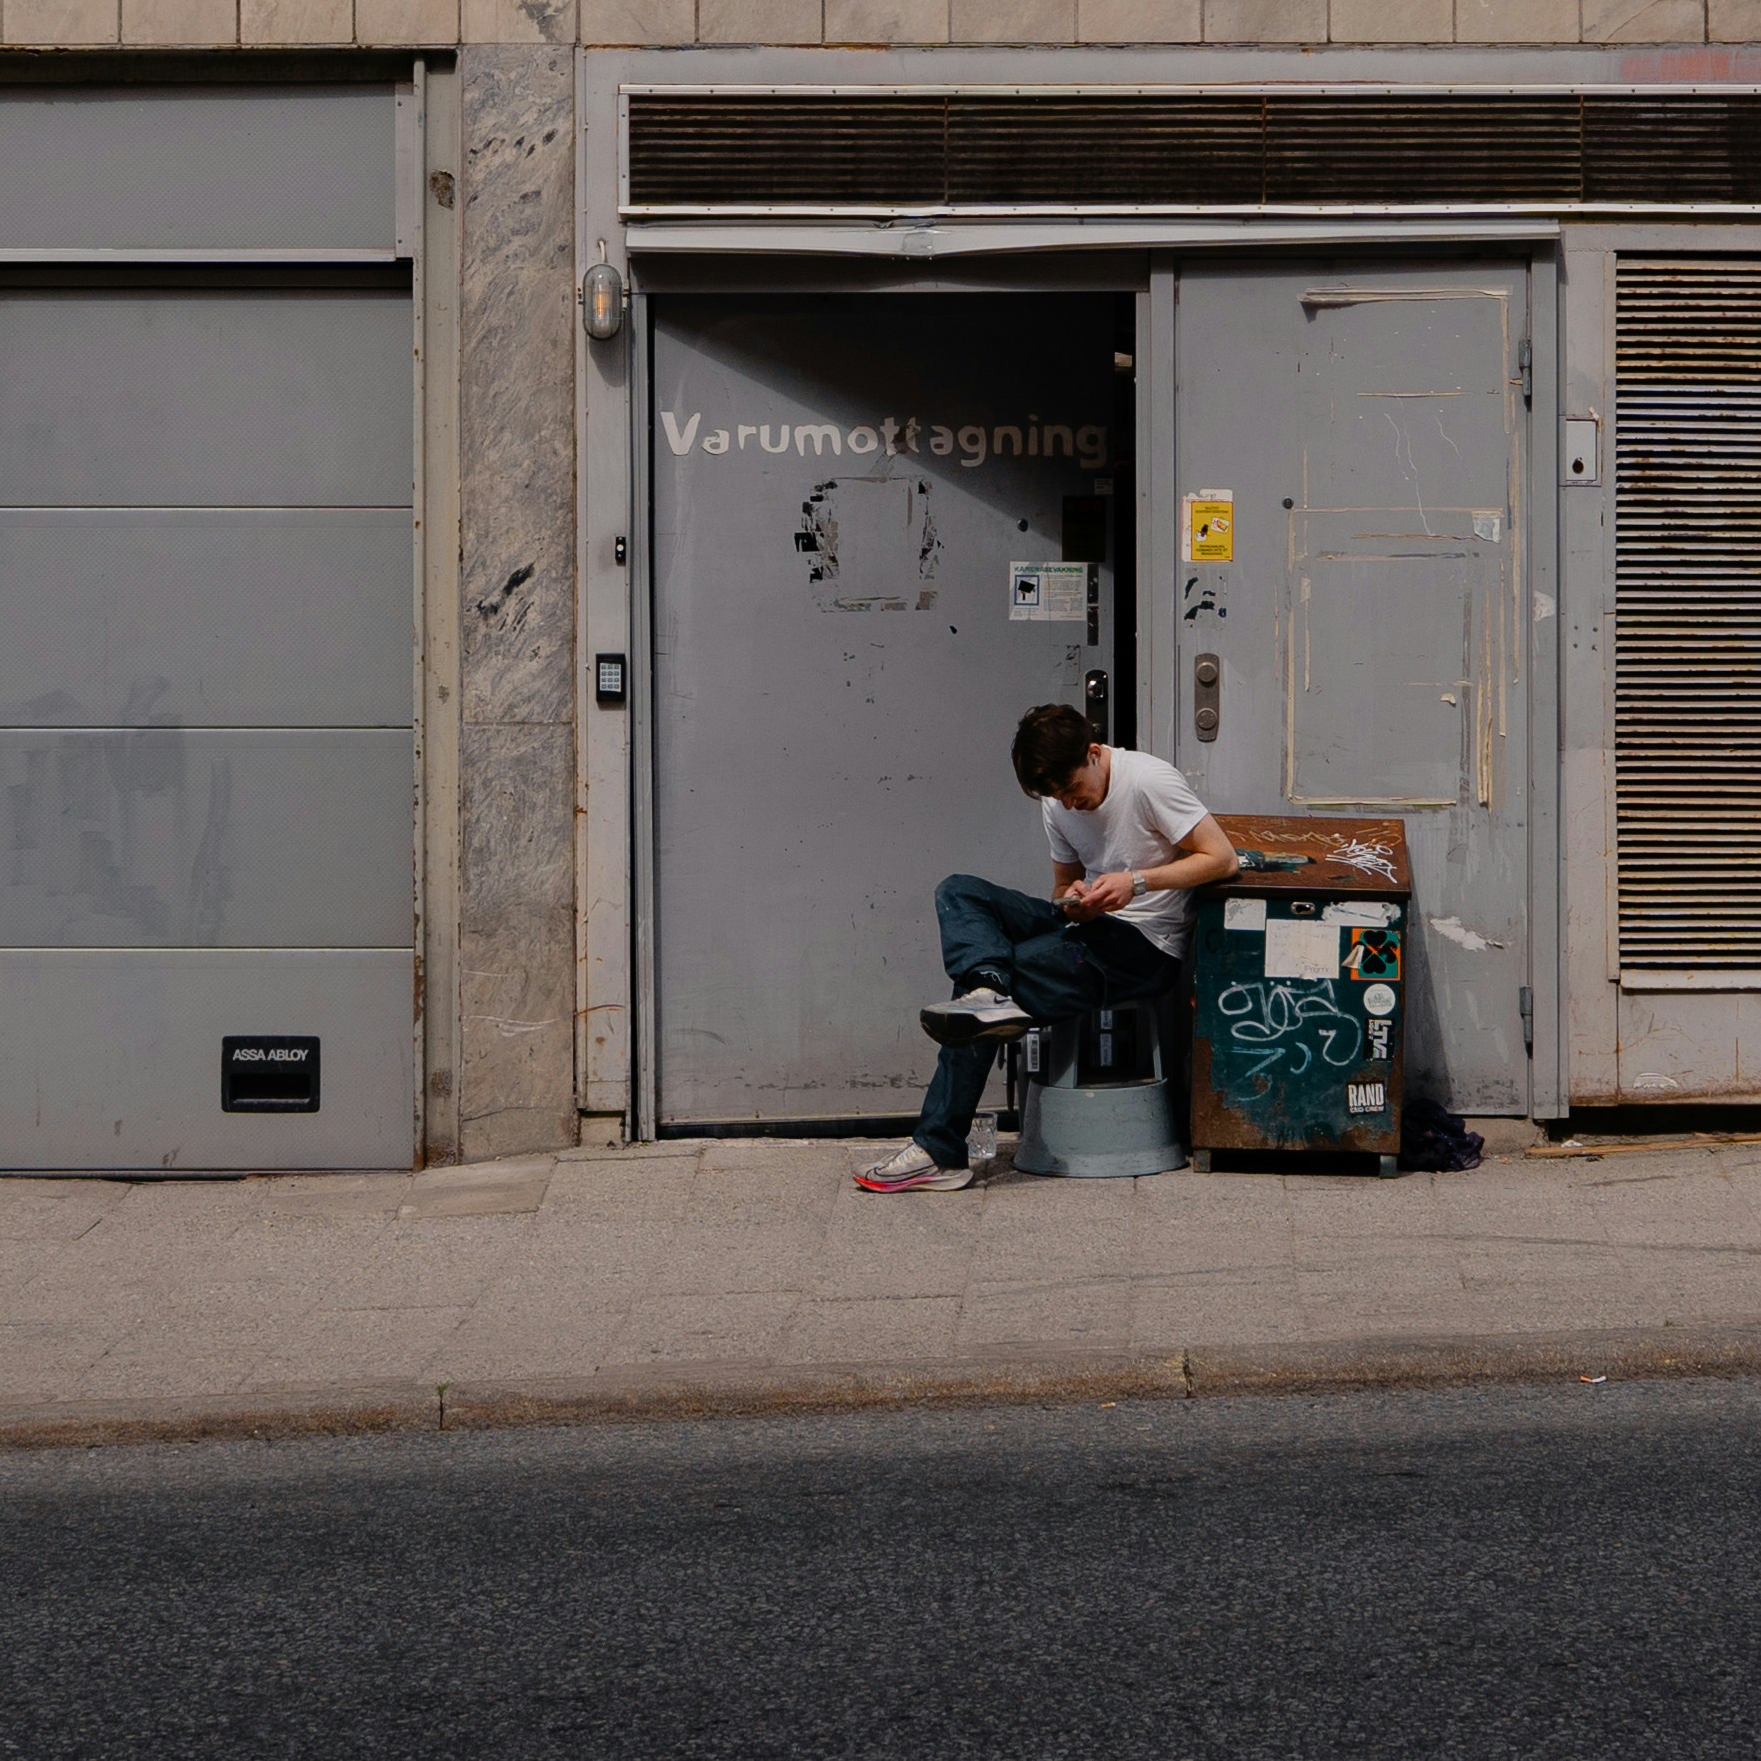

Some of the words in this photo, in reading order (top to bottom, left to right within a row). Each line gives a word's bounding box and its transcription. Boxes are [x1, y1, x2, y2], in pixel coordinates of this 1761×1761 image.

[232, 1049, 266, 1061] ASSA
[267, 1049, 309, 1061] ABLOY
[1348, 1083, 1384, 1106] RAND
